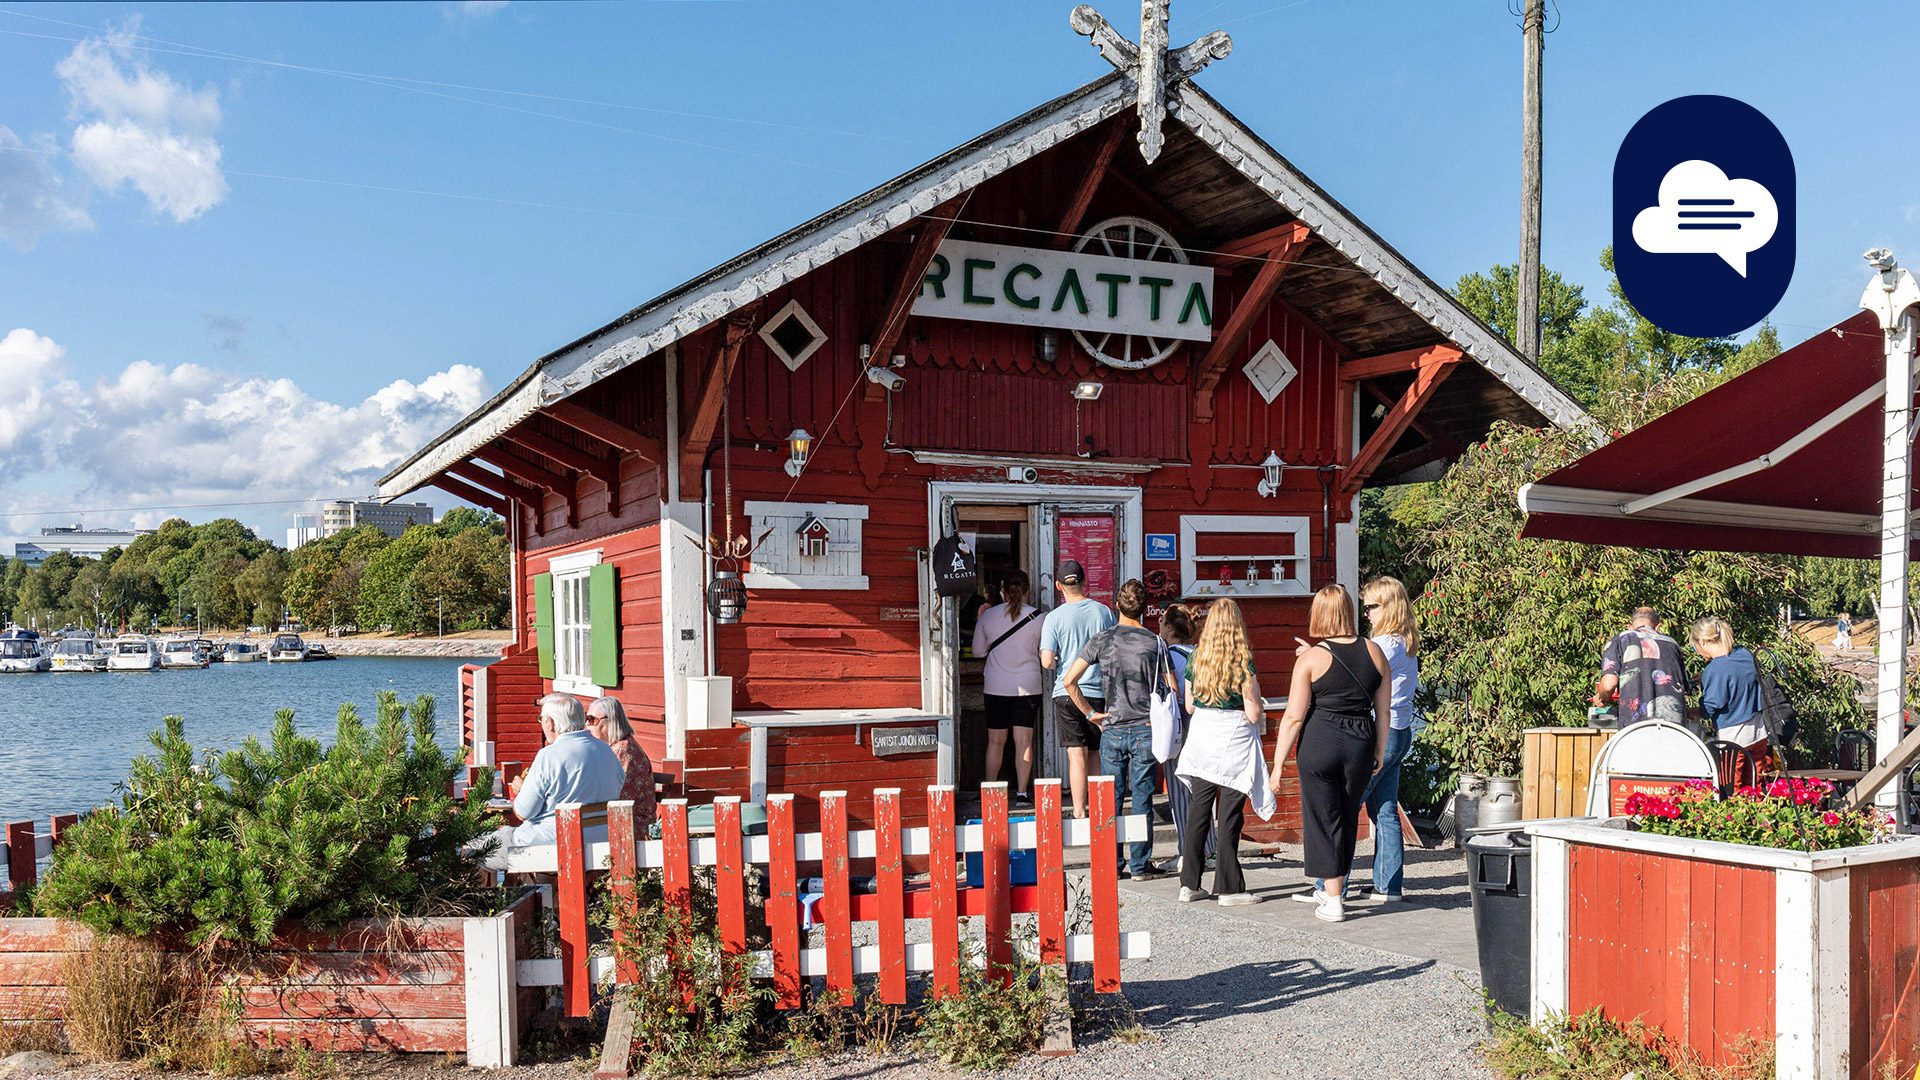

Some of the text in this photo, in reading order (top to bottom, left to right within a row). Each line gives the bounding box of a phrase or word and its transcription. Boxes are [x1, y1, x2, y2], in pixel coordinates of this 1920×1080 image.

[919, 253, 1212, 326] REGATTA
[944, 571, 977, 579] REGATTA
[1633, 785, 1672, 795] HINNAS
